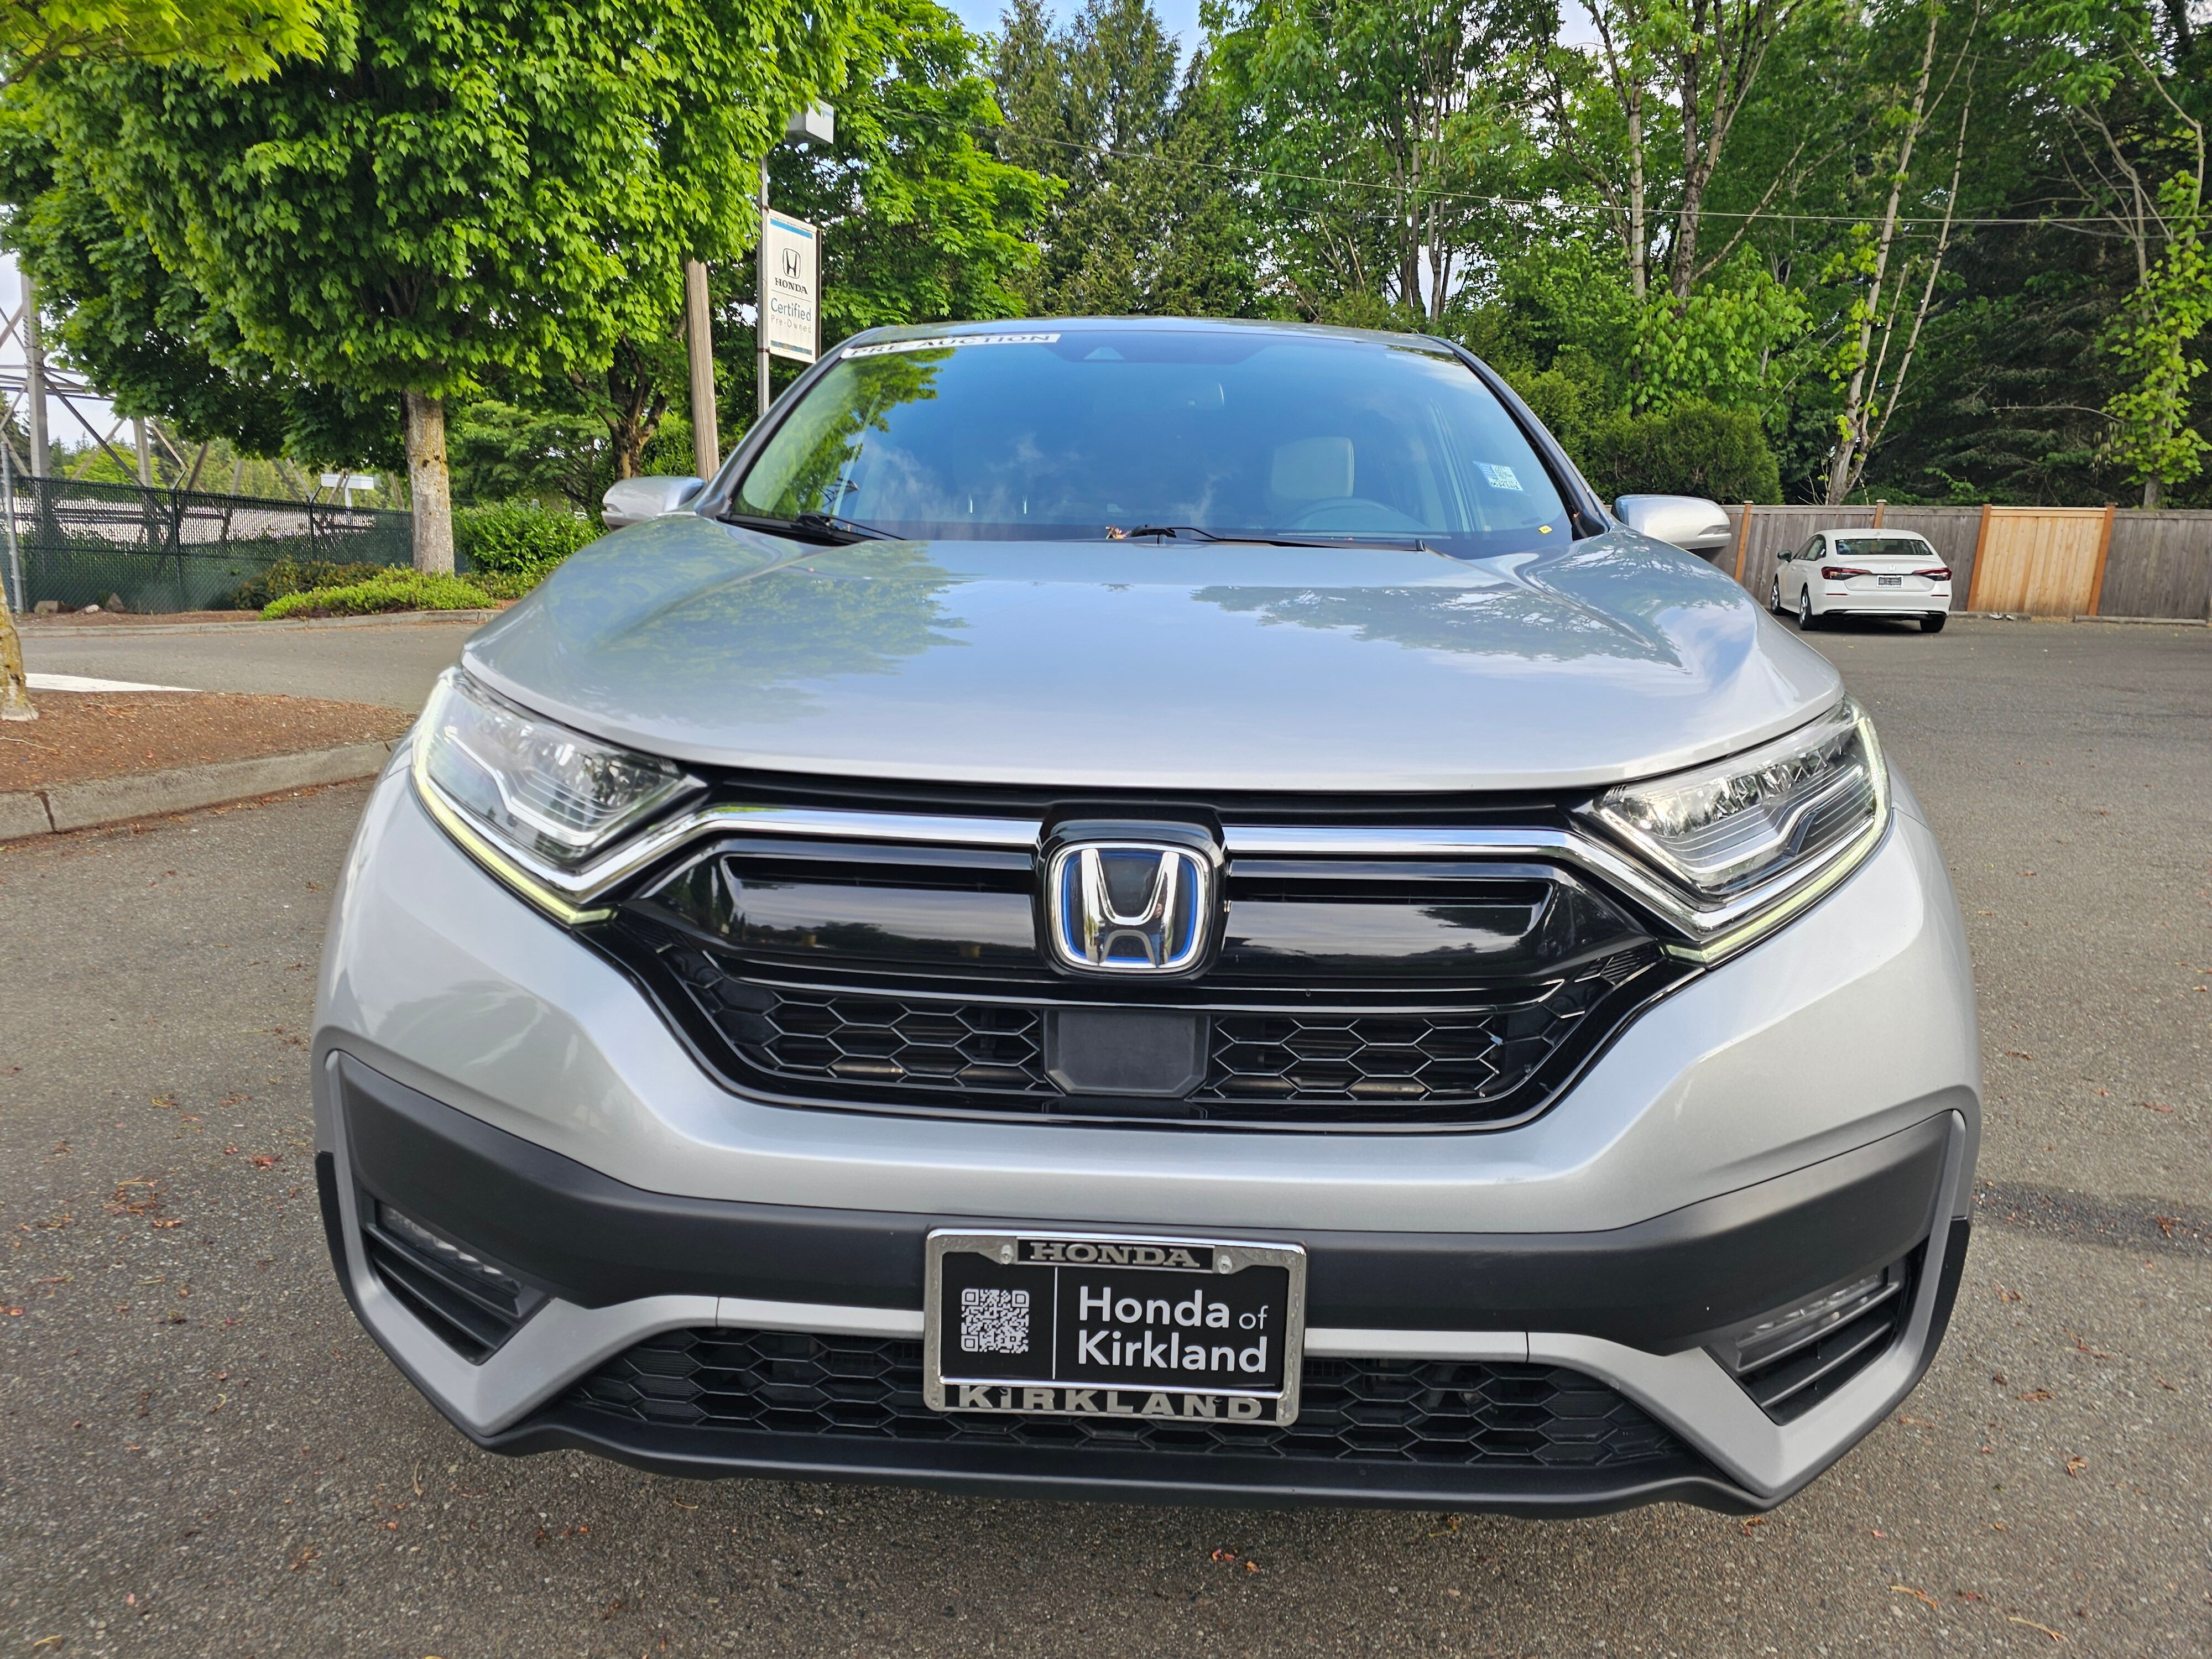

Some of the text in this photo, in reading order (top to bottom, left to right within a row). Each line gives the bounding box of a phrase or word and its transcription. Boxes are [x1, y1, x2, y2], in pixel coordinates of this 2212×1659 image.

[775, 278, 808, 295] HONDA
[771, 298, 811, 322] Certified
[771, 315, 811, 333] Pre-Owned
[1030, 1242, 1199, 1267] HONDA
[1079, 1286, 1268, 1329] Honda of
[1078, 1330, 1267, 1373] Kirkland
[959, 1386, 1262, 1419] KIRKLAND
